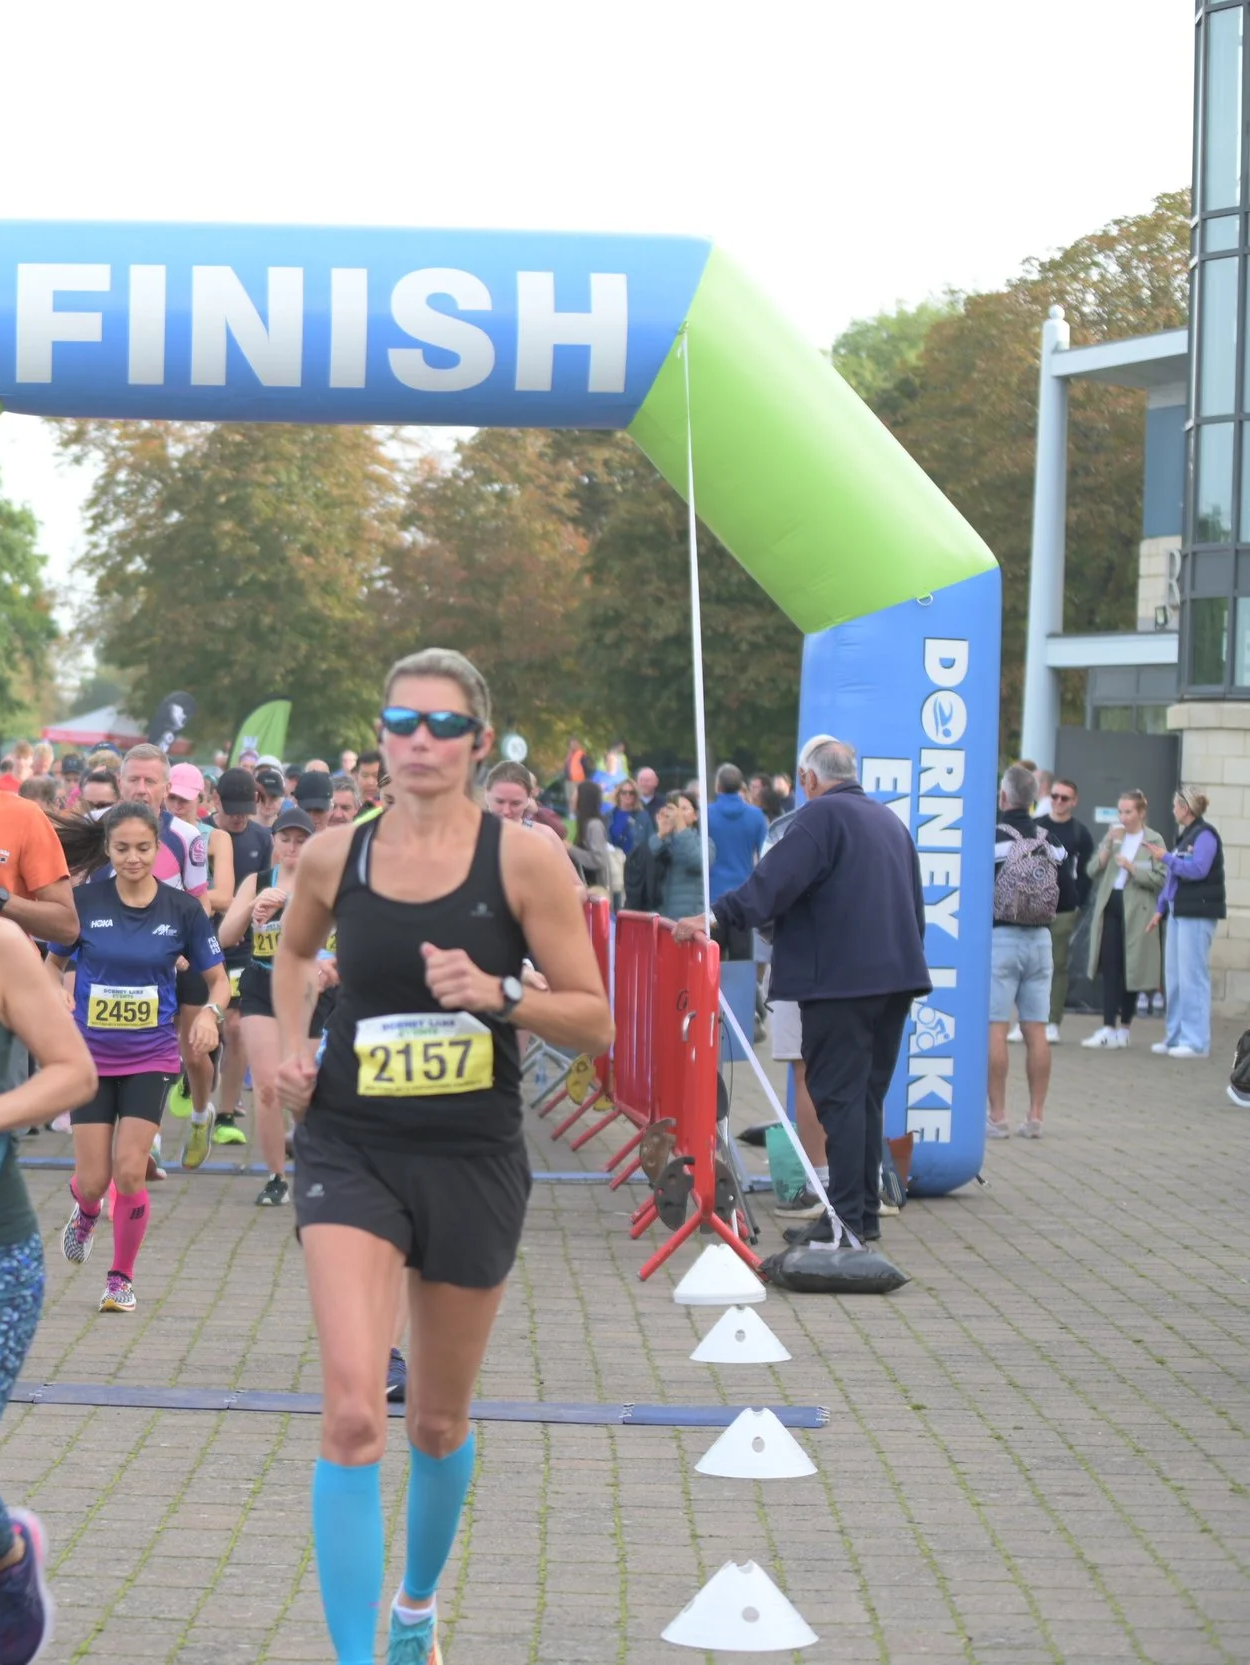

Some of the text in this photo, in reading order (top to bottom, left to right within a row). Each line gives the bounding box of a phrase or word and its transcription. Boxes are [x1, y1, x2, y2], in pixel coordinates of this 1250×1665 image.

[15, 262, 628, 393] FINISH
[91, 919, 113, 928] HOKA
[95, 999, 151, 1023] 2459
[369, 1039, 474, 1083] 2157
